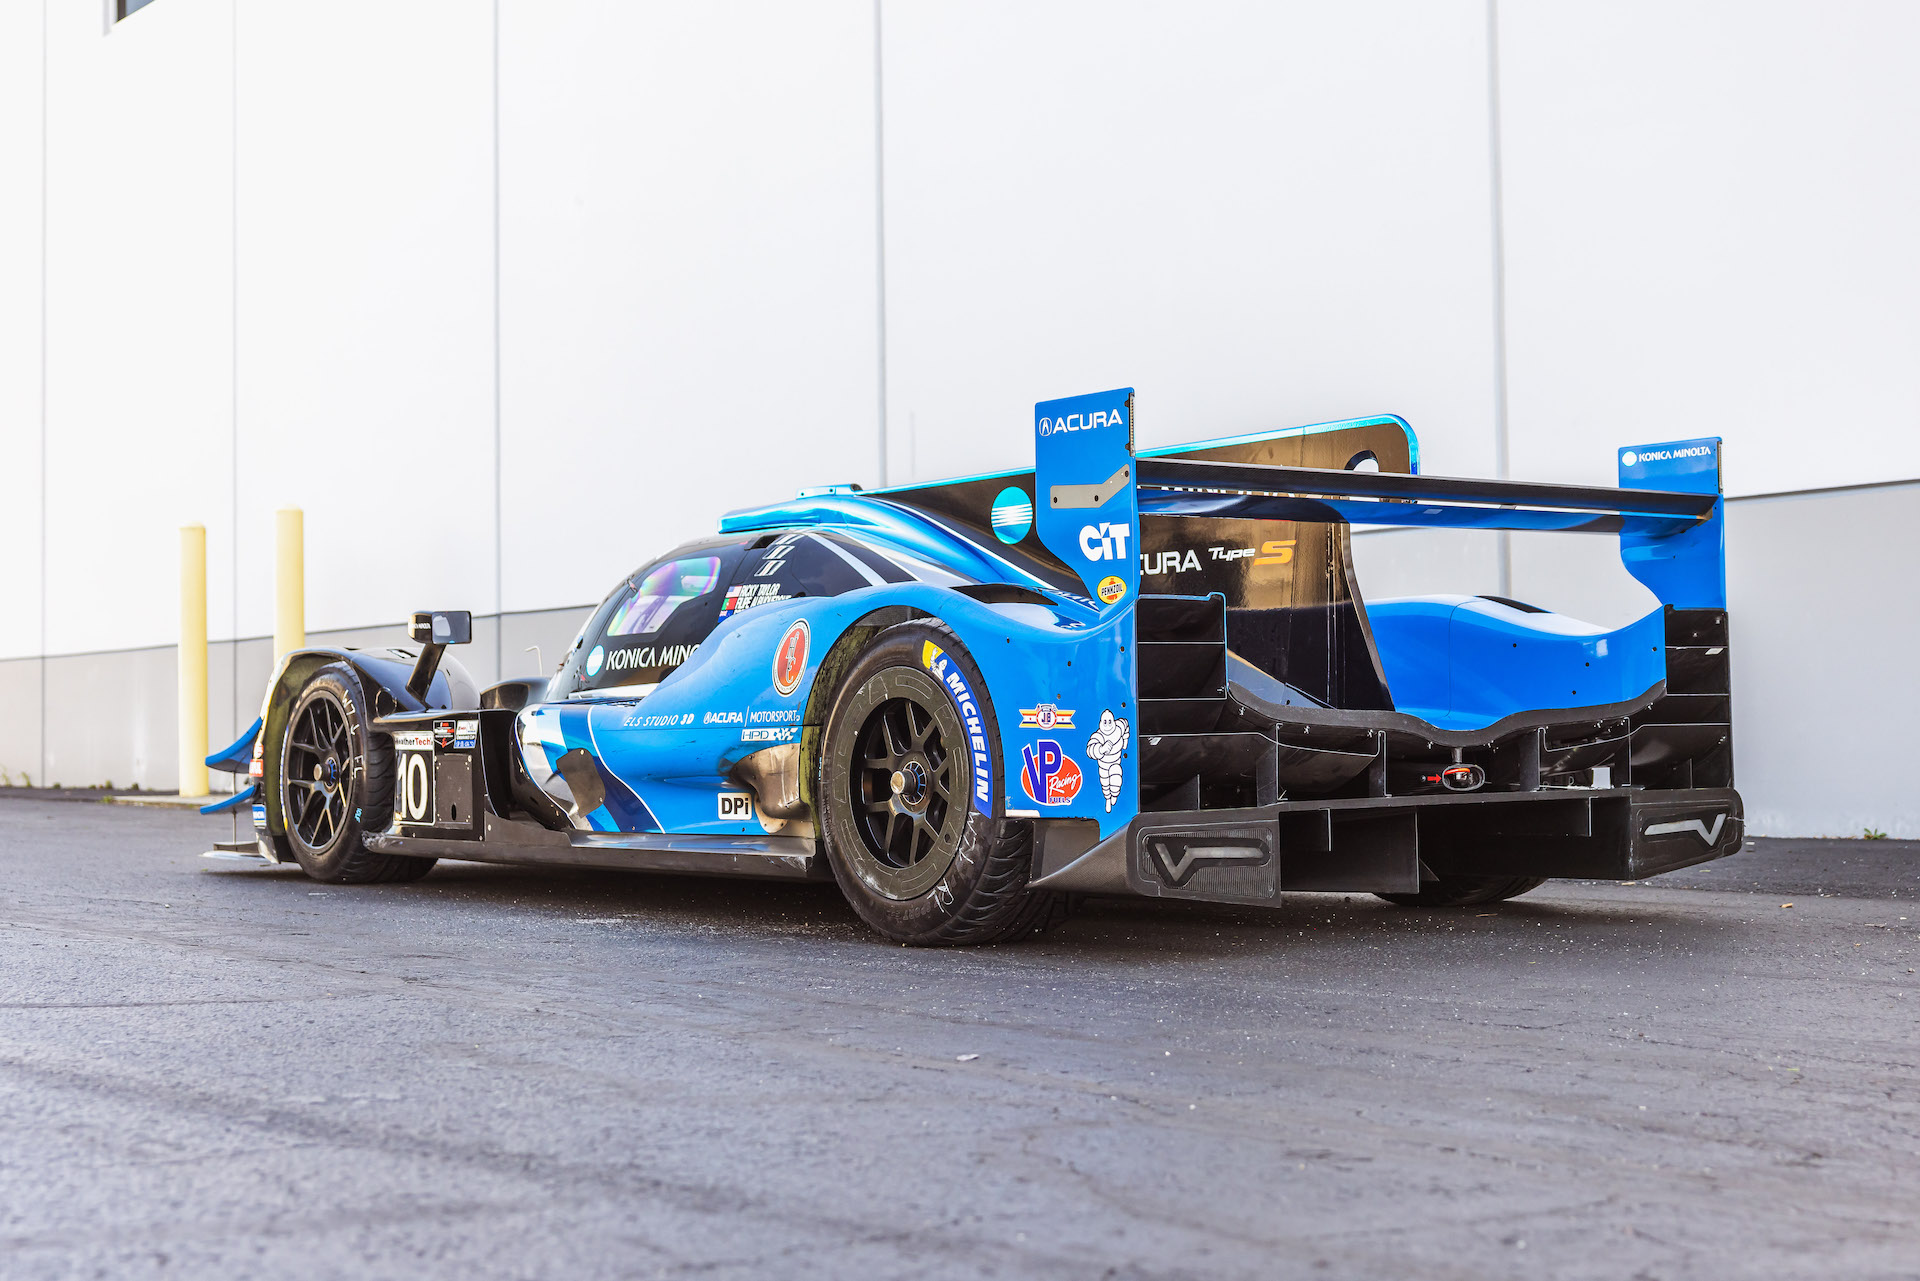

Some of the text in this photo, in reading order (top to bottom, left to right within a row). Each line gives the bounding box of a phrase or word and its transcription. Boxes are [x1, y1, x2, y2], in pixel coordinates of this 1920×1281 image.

[1053, 409, 1123, 434] ACURA
[1639, 446, 1711, 462] KONICA MINOLTA
[1140, 549, 1202, 576] URA
[1253, 540, 1296, 566] S
[1101, 582, 1123, 597] PENNZOIL
[606, 647, 656, 671] KONICA
[623, 713, 695, 727] ELS STUDIO 3D
[710, 712, 743, 724] ACURA
[742, 730, 770, 740] HPD
[946, 671, 990, 803] MICHELIN
[1021, 739, 1081, 804] VP Racing
[398, 753, 428, 820] 10
[721, 797, 749, 815] DPi
